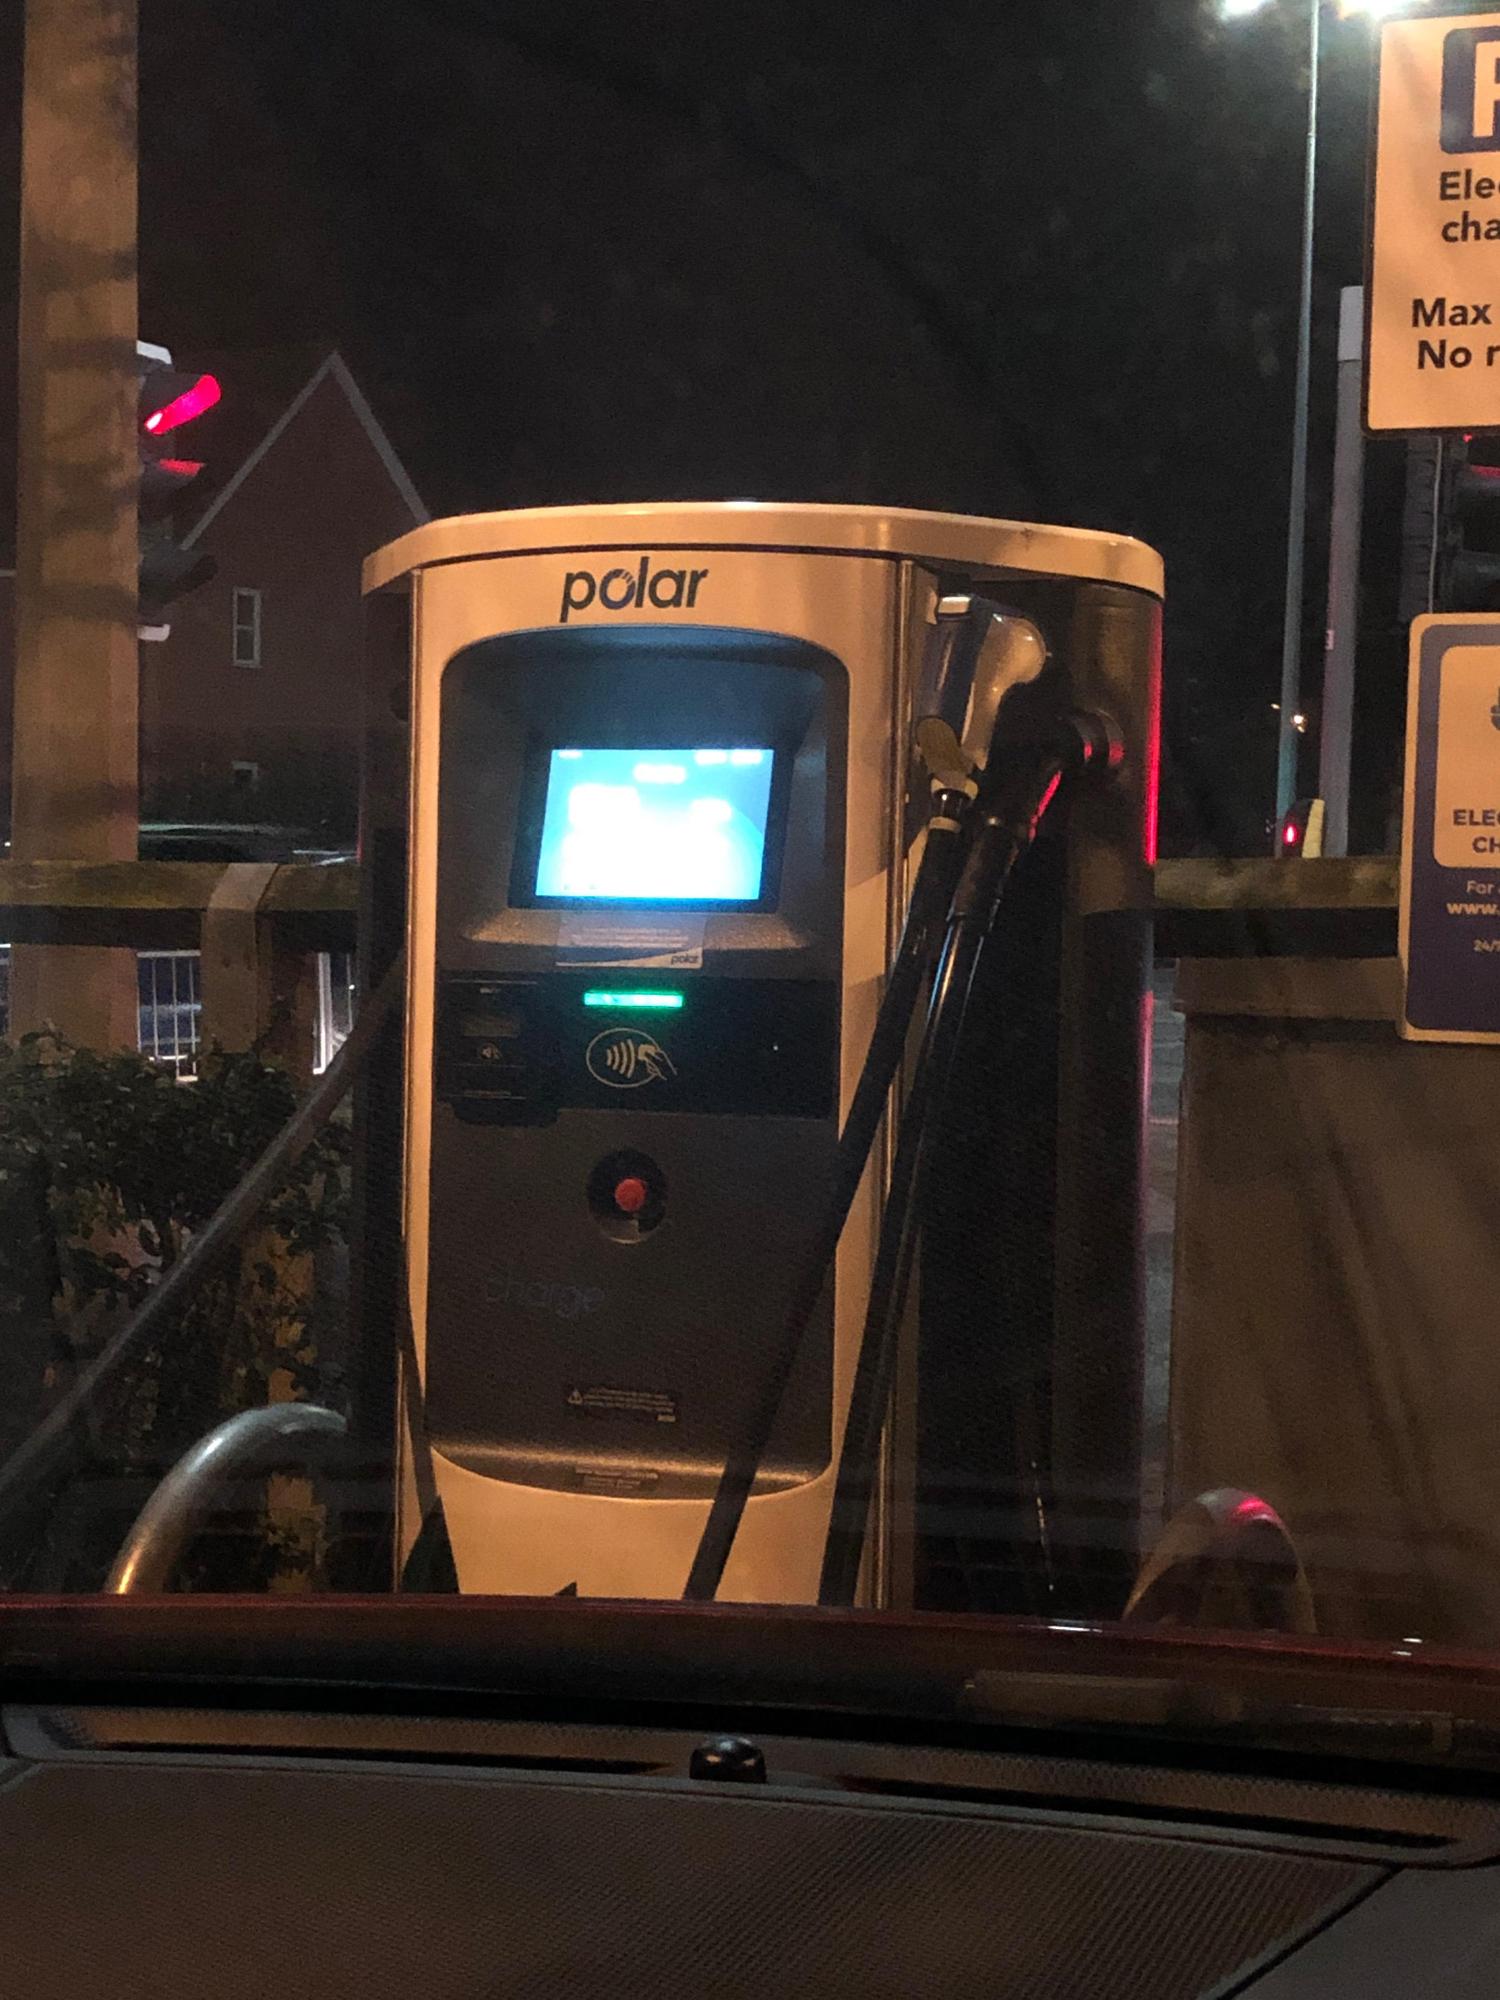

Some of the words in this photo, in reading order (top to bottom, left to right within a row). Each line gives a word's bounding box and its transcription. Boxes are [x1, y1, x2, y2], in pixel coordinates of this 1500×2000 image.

[1439, 168, 1500, 202] Ele
[1411, 297, 1492, 328] Max
[1417, 339, 1472, 369] No
[560, 556, 710, 623] polar
[1452, 808, 1500, 827] ELE
[1466, 880, 1496, 895] For
